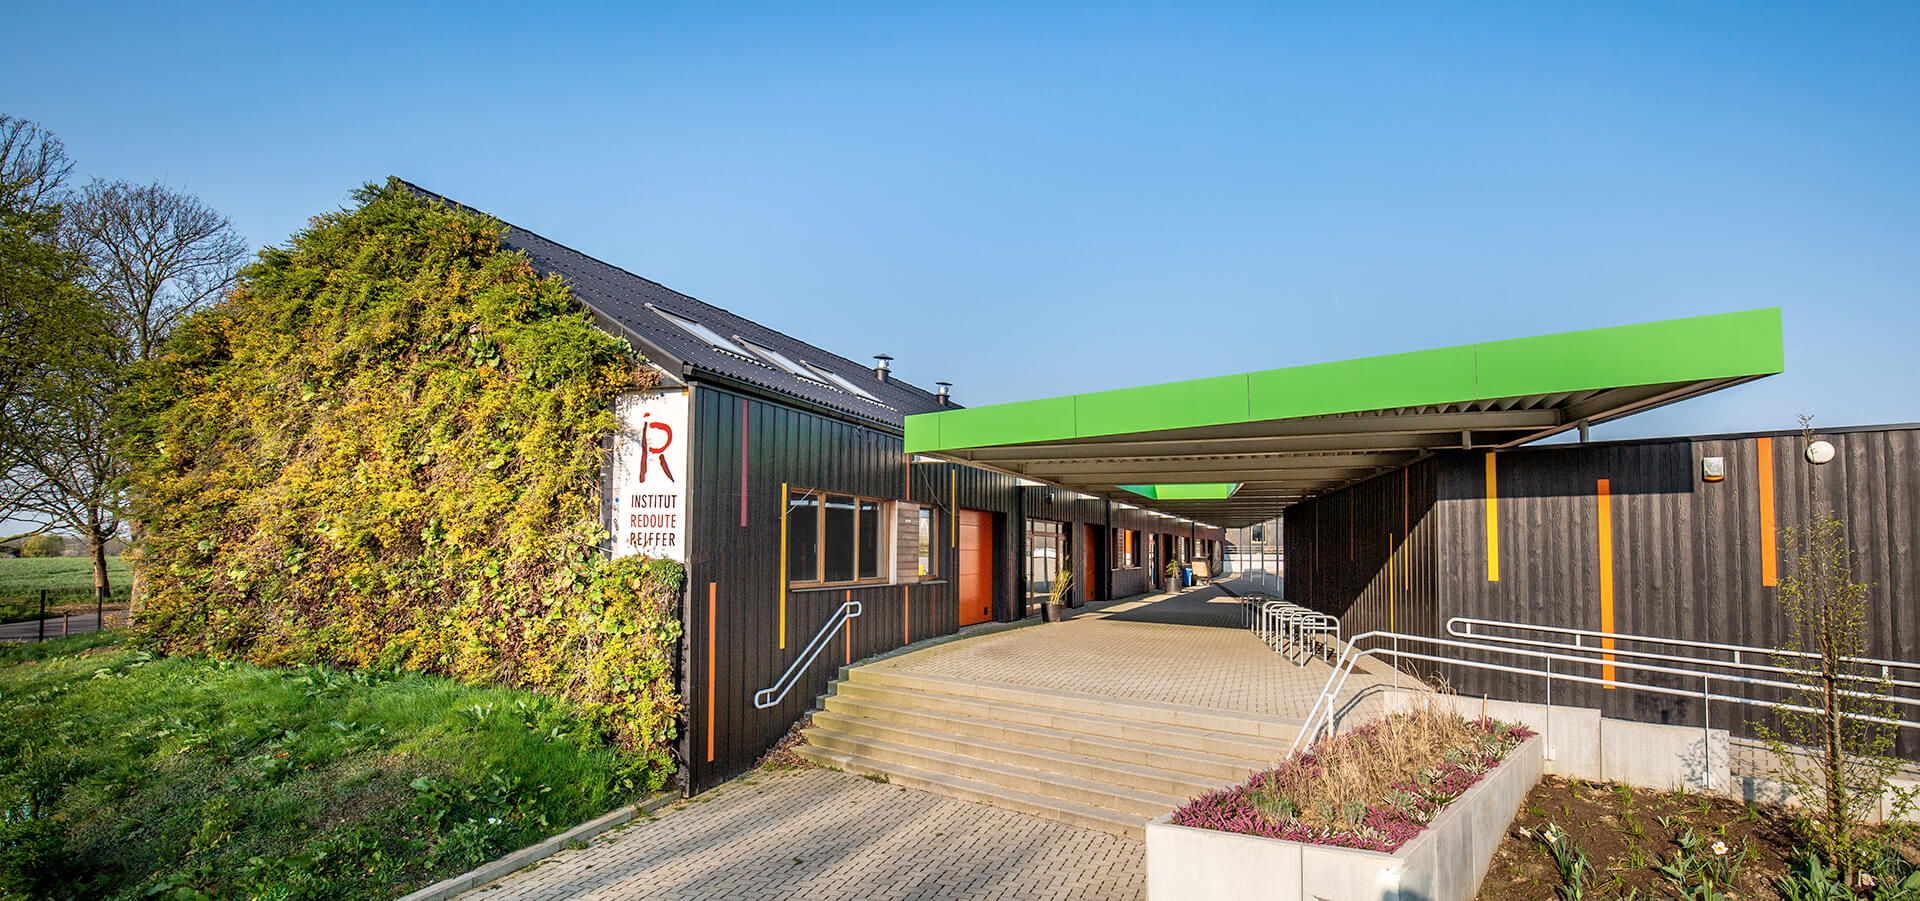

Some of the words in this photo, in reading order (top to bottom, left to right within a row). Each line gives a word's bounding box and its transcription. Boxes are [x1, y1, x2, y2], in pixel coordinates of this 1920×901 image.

[631, 494, 677, 508] INSTITUT
[630, 514, 676, 528] REDOUTE
[630, 532, 676, 546] PEIFFER
